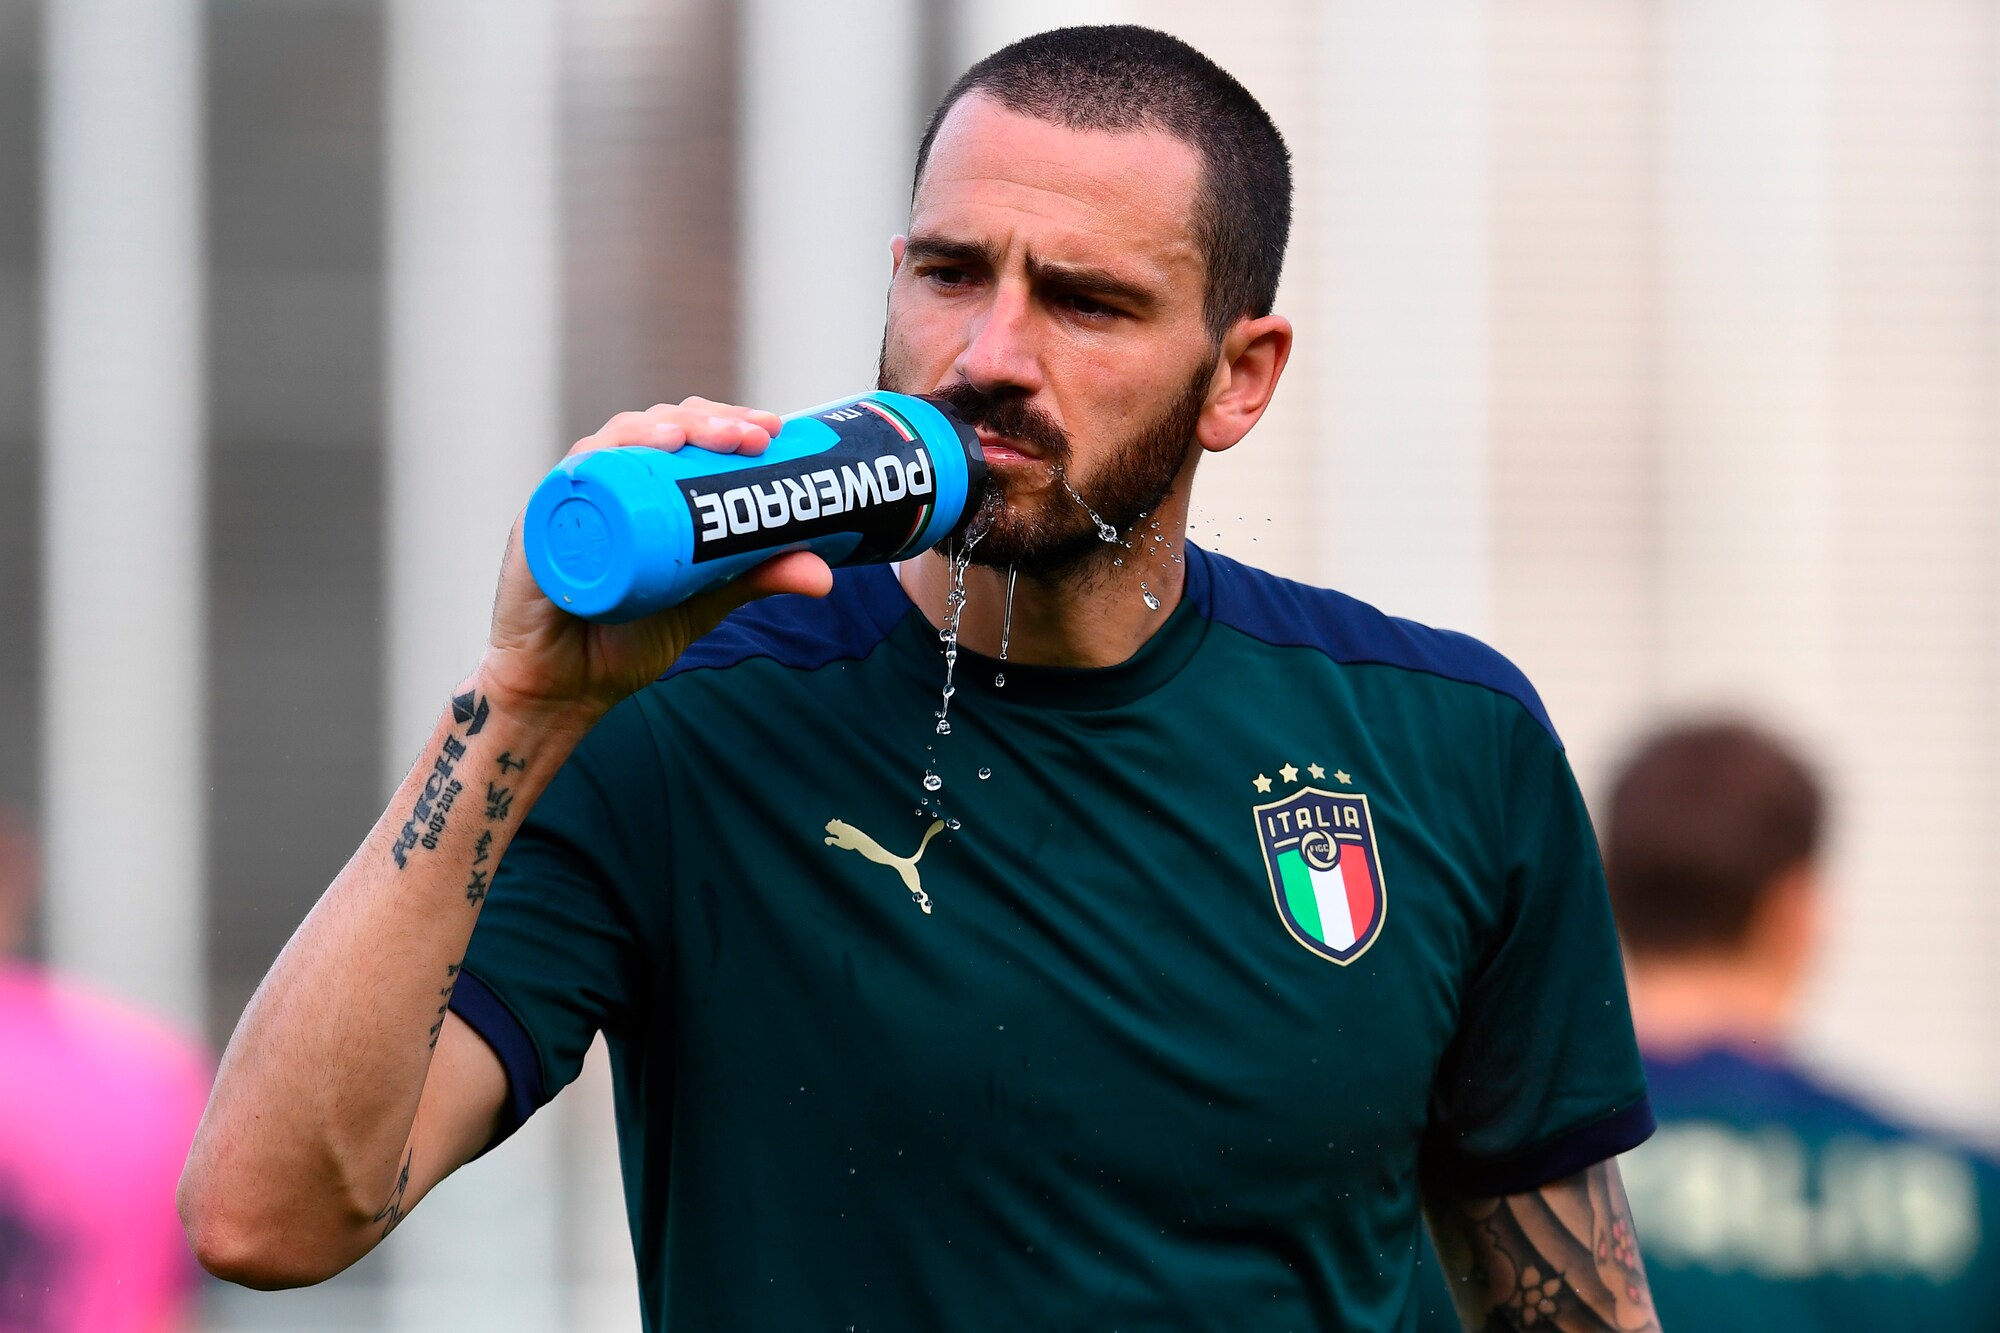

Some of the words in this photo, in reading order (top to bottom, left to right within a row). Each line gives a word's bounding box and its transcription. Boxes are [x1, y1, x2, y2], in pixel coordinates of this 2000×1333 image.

[823, 408, 863, 422] ITA
[694, 447, 934, 542] POWERADE
[1267, 805, 1360, 837] ITALIA
